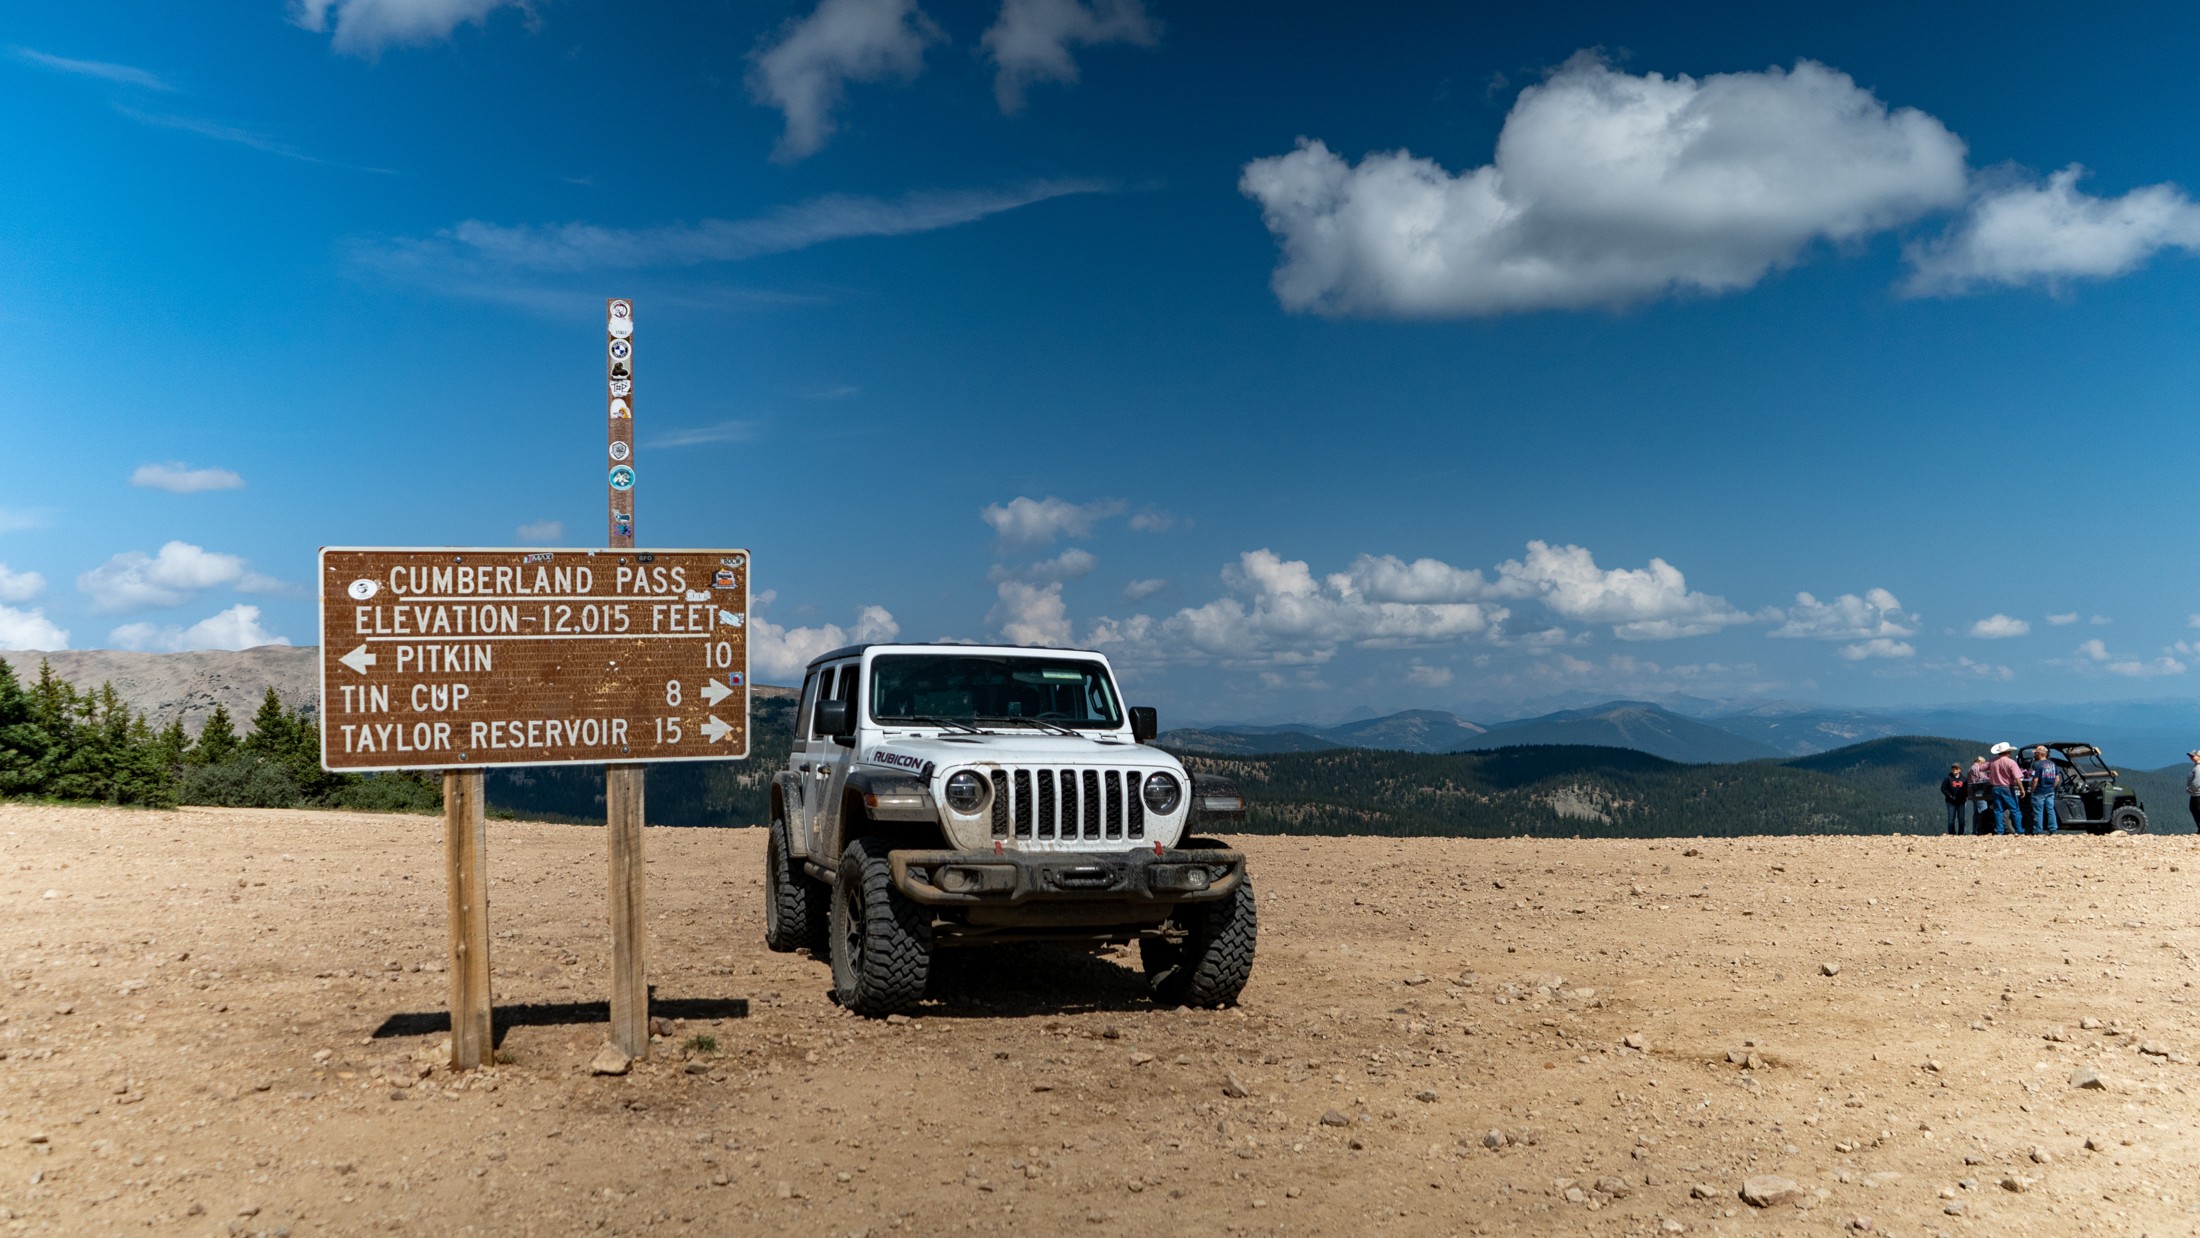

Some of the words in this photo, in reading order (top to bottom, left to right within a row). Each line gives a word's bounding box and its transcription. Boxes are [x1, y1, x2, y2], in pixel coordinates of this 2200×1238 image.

[390, 566, 593, 594] CUMBERLAND
[616, 566, 687, 593] PASS
[652, 604, 719, 631] FEET
[396, 644, 492, 673] PITKIN
[704, 641, 732, 668] 10
[339, 684, 389, 713] TIN
[411, 683, 470, 712] CUP
[666, 679, 682, 707] 8
[340, 722, 451, 753] TAYLOR
[471, 718, 629, 749] RESERVOIR
[655, 716, 682, 744] 15
[873, 751, 923, 769] RUBICON
